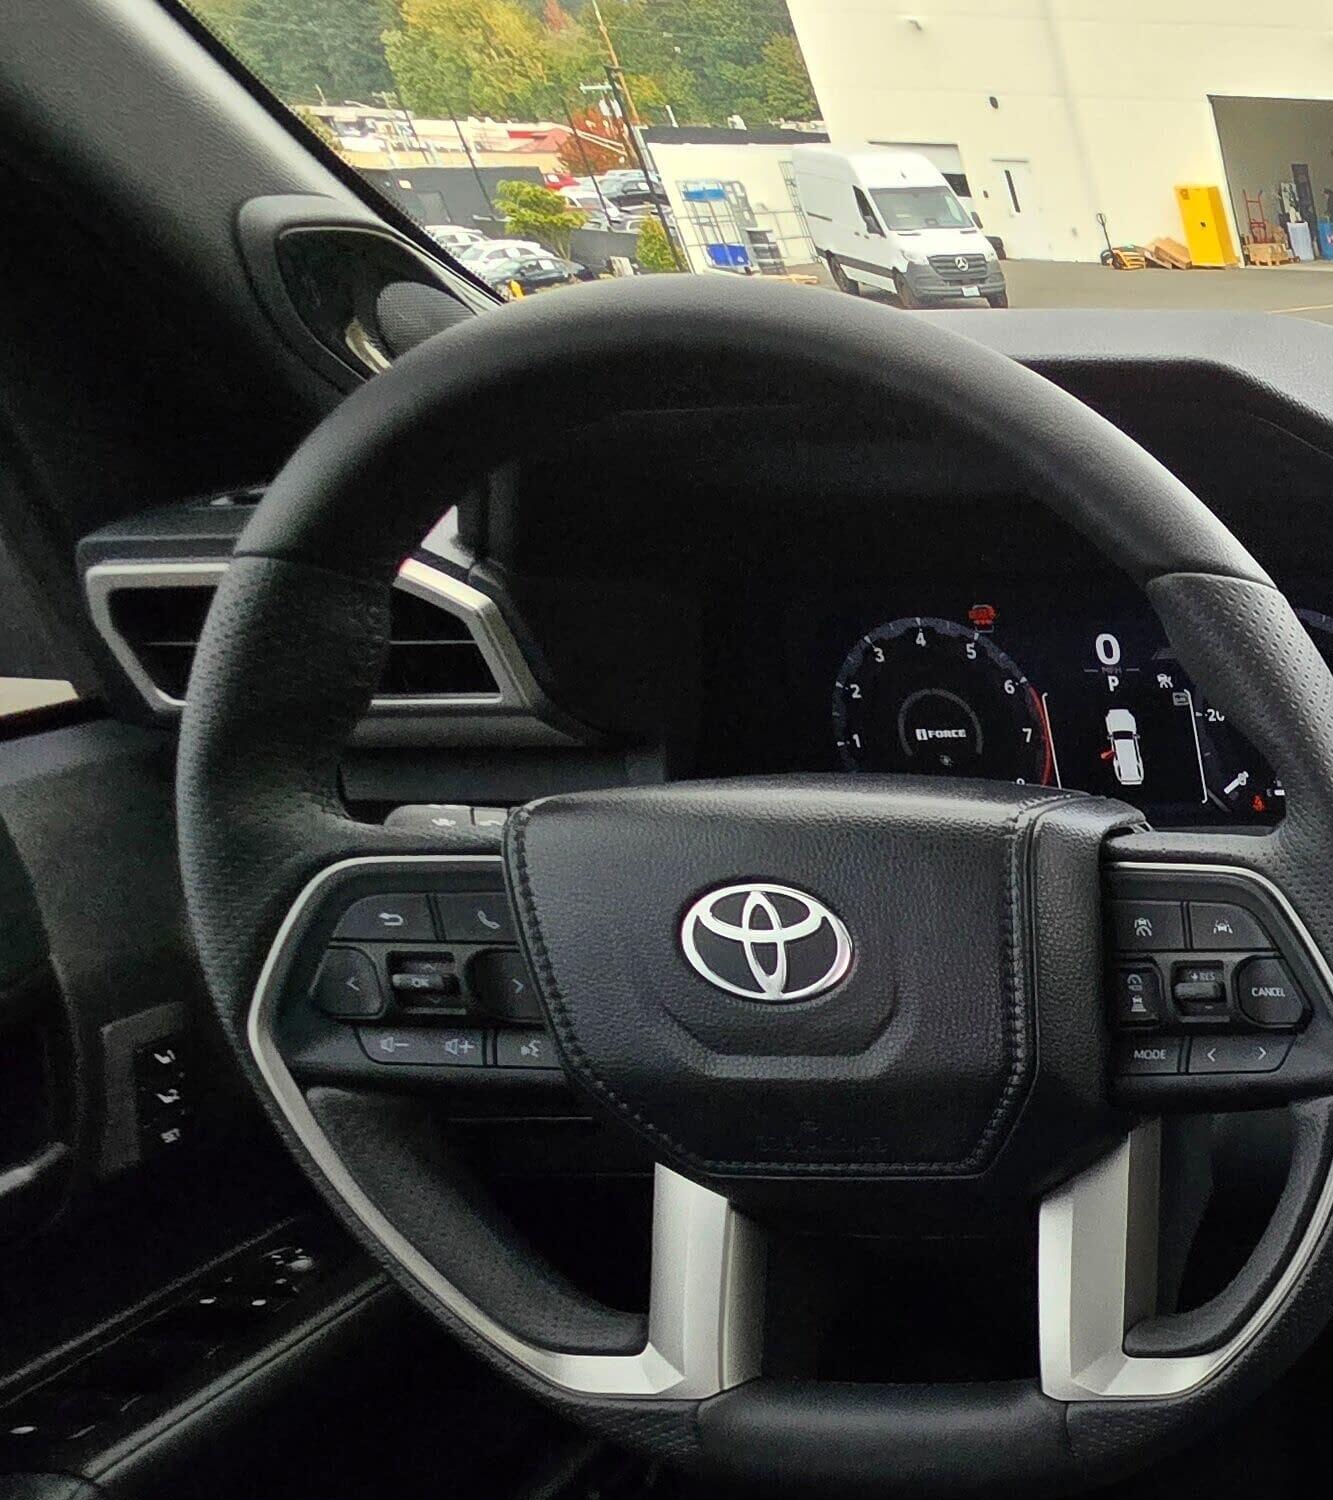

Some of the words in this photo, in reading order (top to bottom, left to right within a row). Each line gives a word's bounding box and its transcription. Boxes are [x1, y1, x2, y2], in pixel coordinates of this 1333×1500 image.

[916, 632, 926, 646] 4
[873, 648, 885, 662] 3
[966, 643, 977, 659] 5
[1095, 633, 1121, 665] 0
[850, 684, 861, 698] 2
[1004, 680, 1015, 694] 6
[1107, 676, 1119, 692] P
[853, 734, 861, 748] 1
[1022, 728, 1032, 742] 7
[1251, 987, 1286, 997] CANCEL
[1134, 1050, 1166, 1060] MODE
